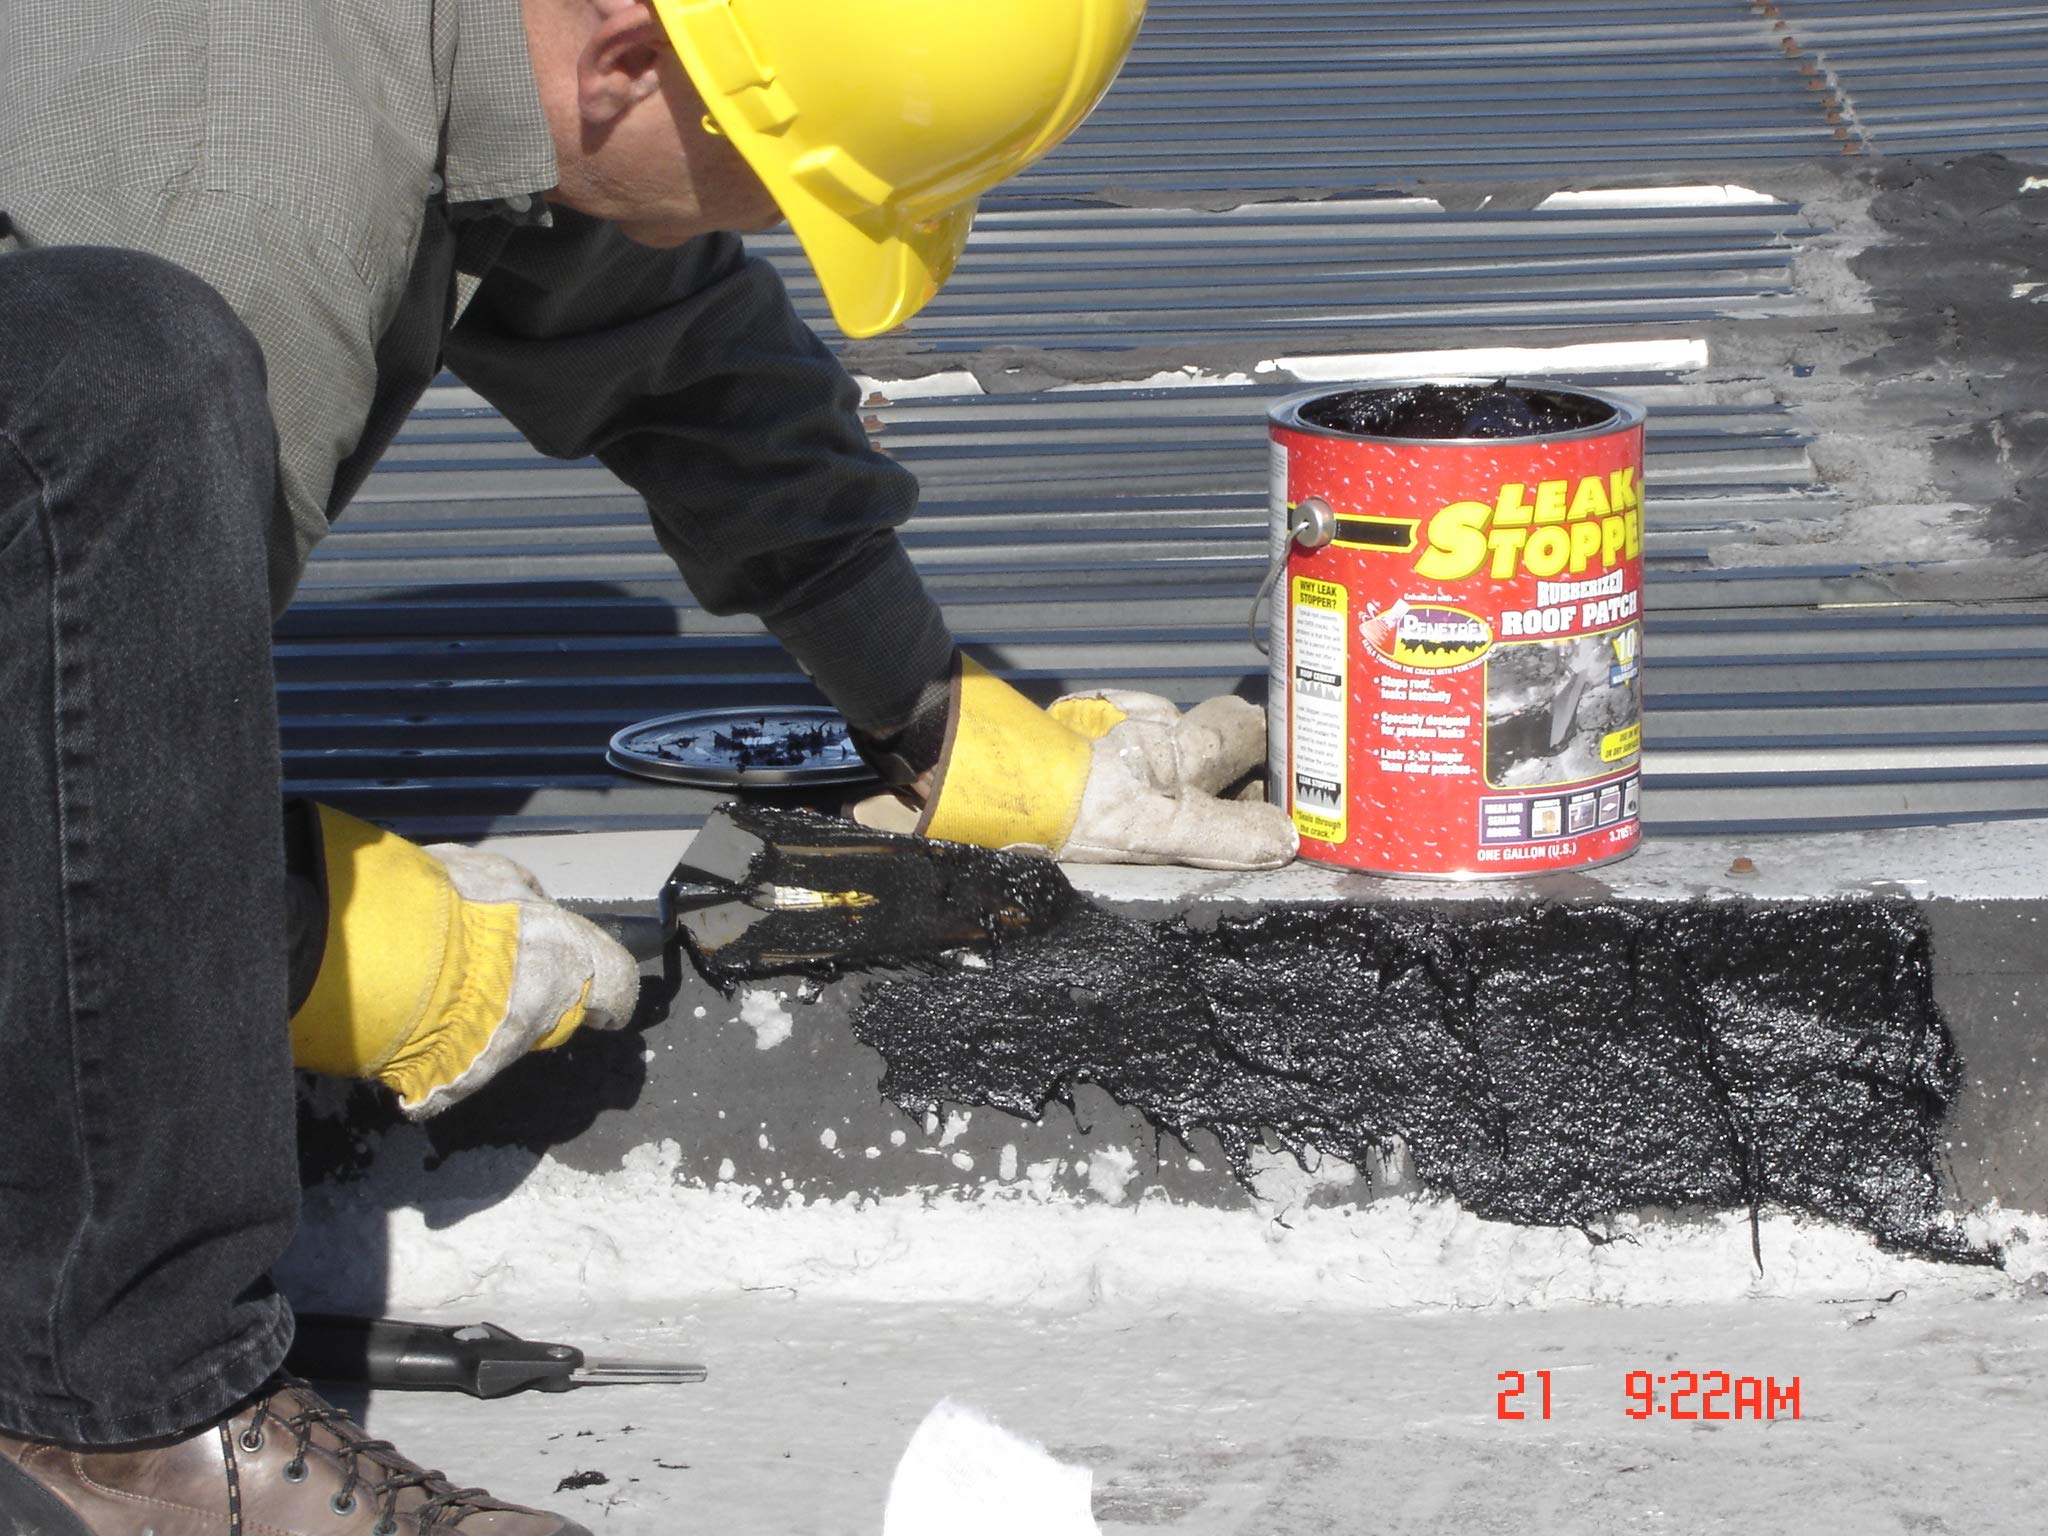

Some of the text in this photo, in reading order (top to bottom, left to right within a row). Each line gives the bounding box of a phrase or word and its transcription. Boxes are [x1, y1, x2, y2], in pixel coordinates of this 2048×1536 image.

[1493, 466, 1637, 527] LEAK
[1300, 581, 1336, 597] WHY LEAK
[1300, 593, 1336, 609] STOPPER?
[1537, 568, 1624, 607] RUBBERIZED
[1402, 614, 1489, 641] PENETREX
[1501, 590, 1638, 636] ROOF PATCH
[1616, 628, 1635, 662] 10
[1477, 843, 1577, 861] ONE GALLON (U.S.)
